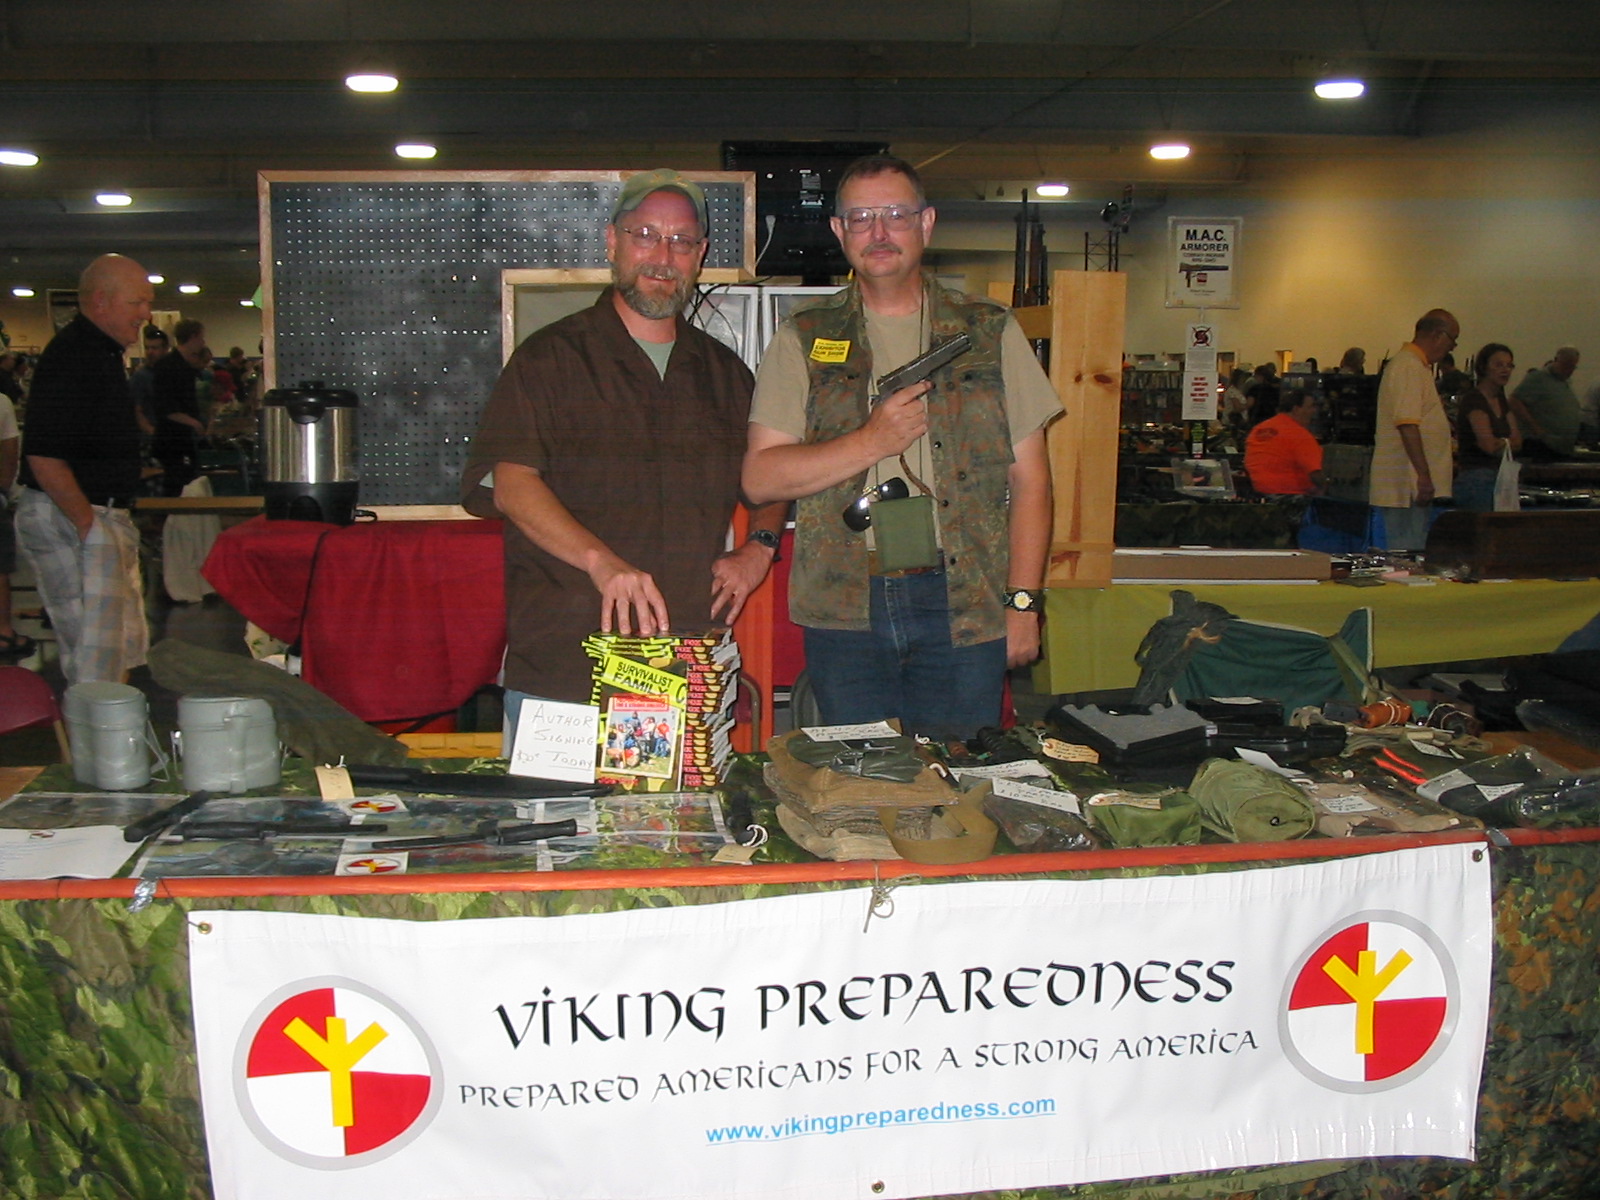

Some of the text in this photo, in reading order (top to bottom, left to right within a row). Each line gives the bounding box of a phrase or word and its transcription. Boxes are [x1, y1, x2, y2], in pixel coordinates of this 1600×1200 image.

[1186, 229, 1227, 241] M.A.C.
[1180, 243, 1229, 251] ARMORER
[613, 672, 669, 694] FAMILY
[616, 661, 673, 688] SURVIVALIST
[532, 703, 594, 728] AUTHOR
[534, 728, 594, 746] SIGNING
[545, 750, 593, 768] TODAY
[492, 960, 1236, 1050] VIKING PREPAREDNESS
[458, 1028, 1259, 1111] PREPARED AMERICANS FOR A STRONG AMERICA
[705, 1098, 1056, 1143] www.vikingpreparedness.com
